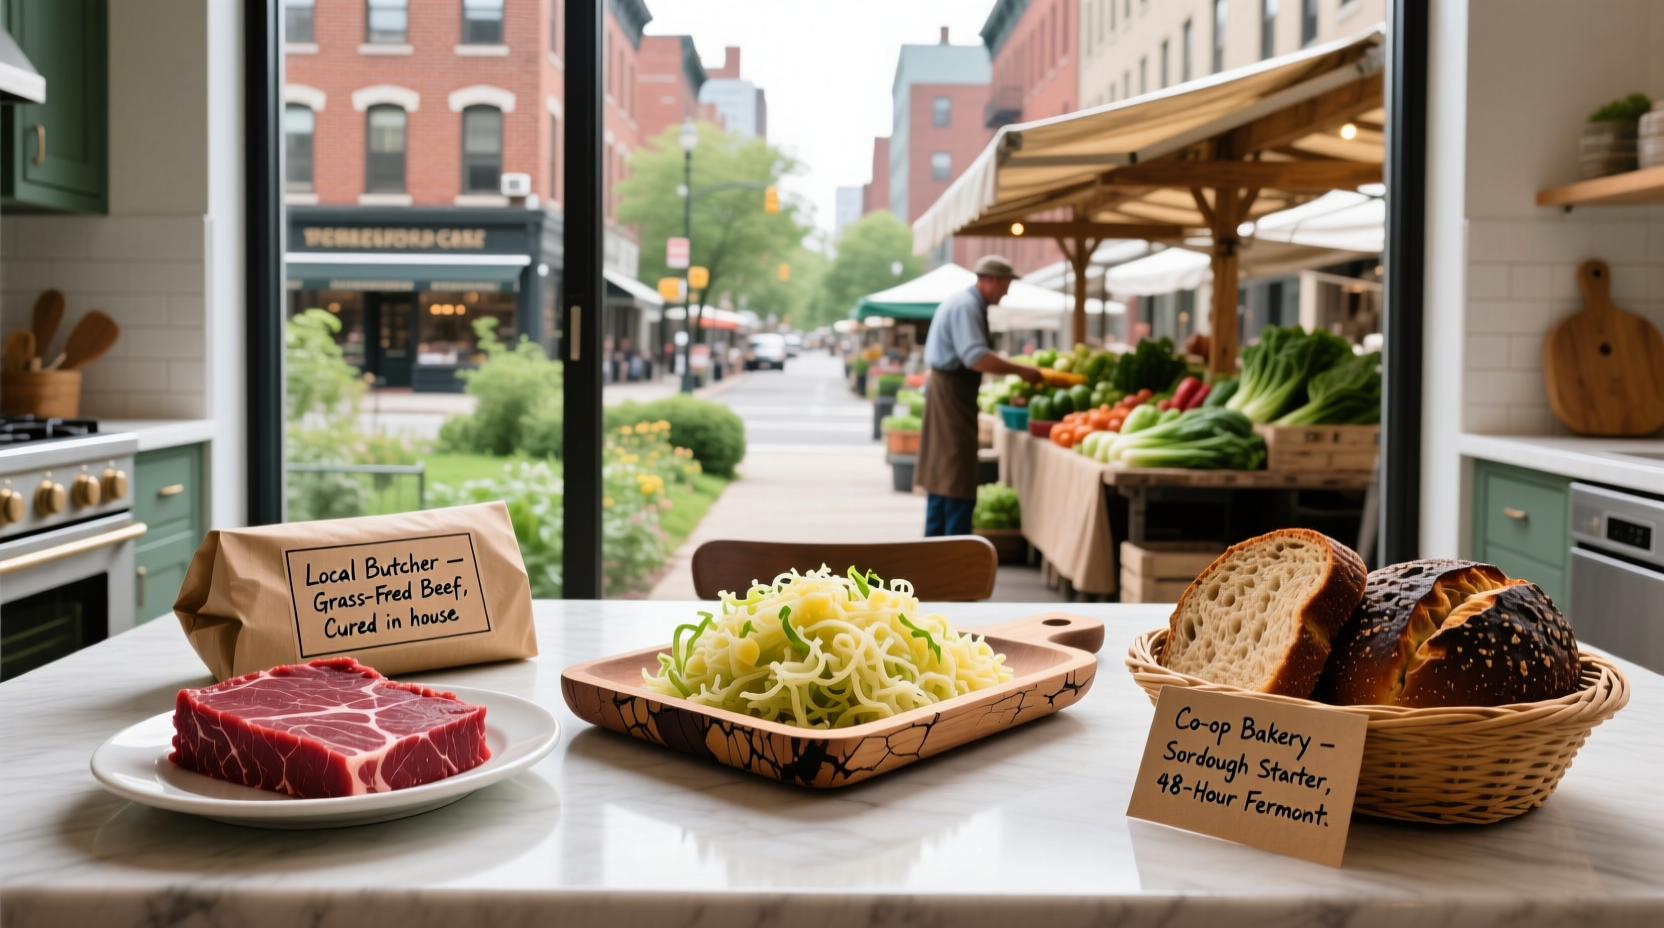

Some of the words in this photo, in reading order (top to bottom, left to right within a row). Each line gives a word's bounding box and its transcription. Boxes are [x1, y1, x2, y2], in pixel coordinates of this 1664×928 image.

[305, 558, 356, 587] Local
[365, 552, 439, 580] Butcher
[420, 575, 468, 601] Beef,
[324, 612, 378, 639] Cured
[386, 613, 402, 630] in
[410, 606, 460, 627] house
[1175, 706, 1232, 746] Co-op
[1240, 716, 1312, 761] Bakery
[1162, 740, 1249, 784] Sordough
[1257, 758, 1331, 796] Starter,
[1156, 772, 1238, 808] 48-Hour
[1243, 789, 1329, 828] Fermont.
